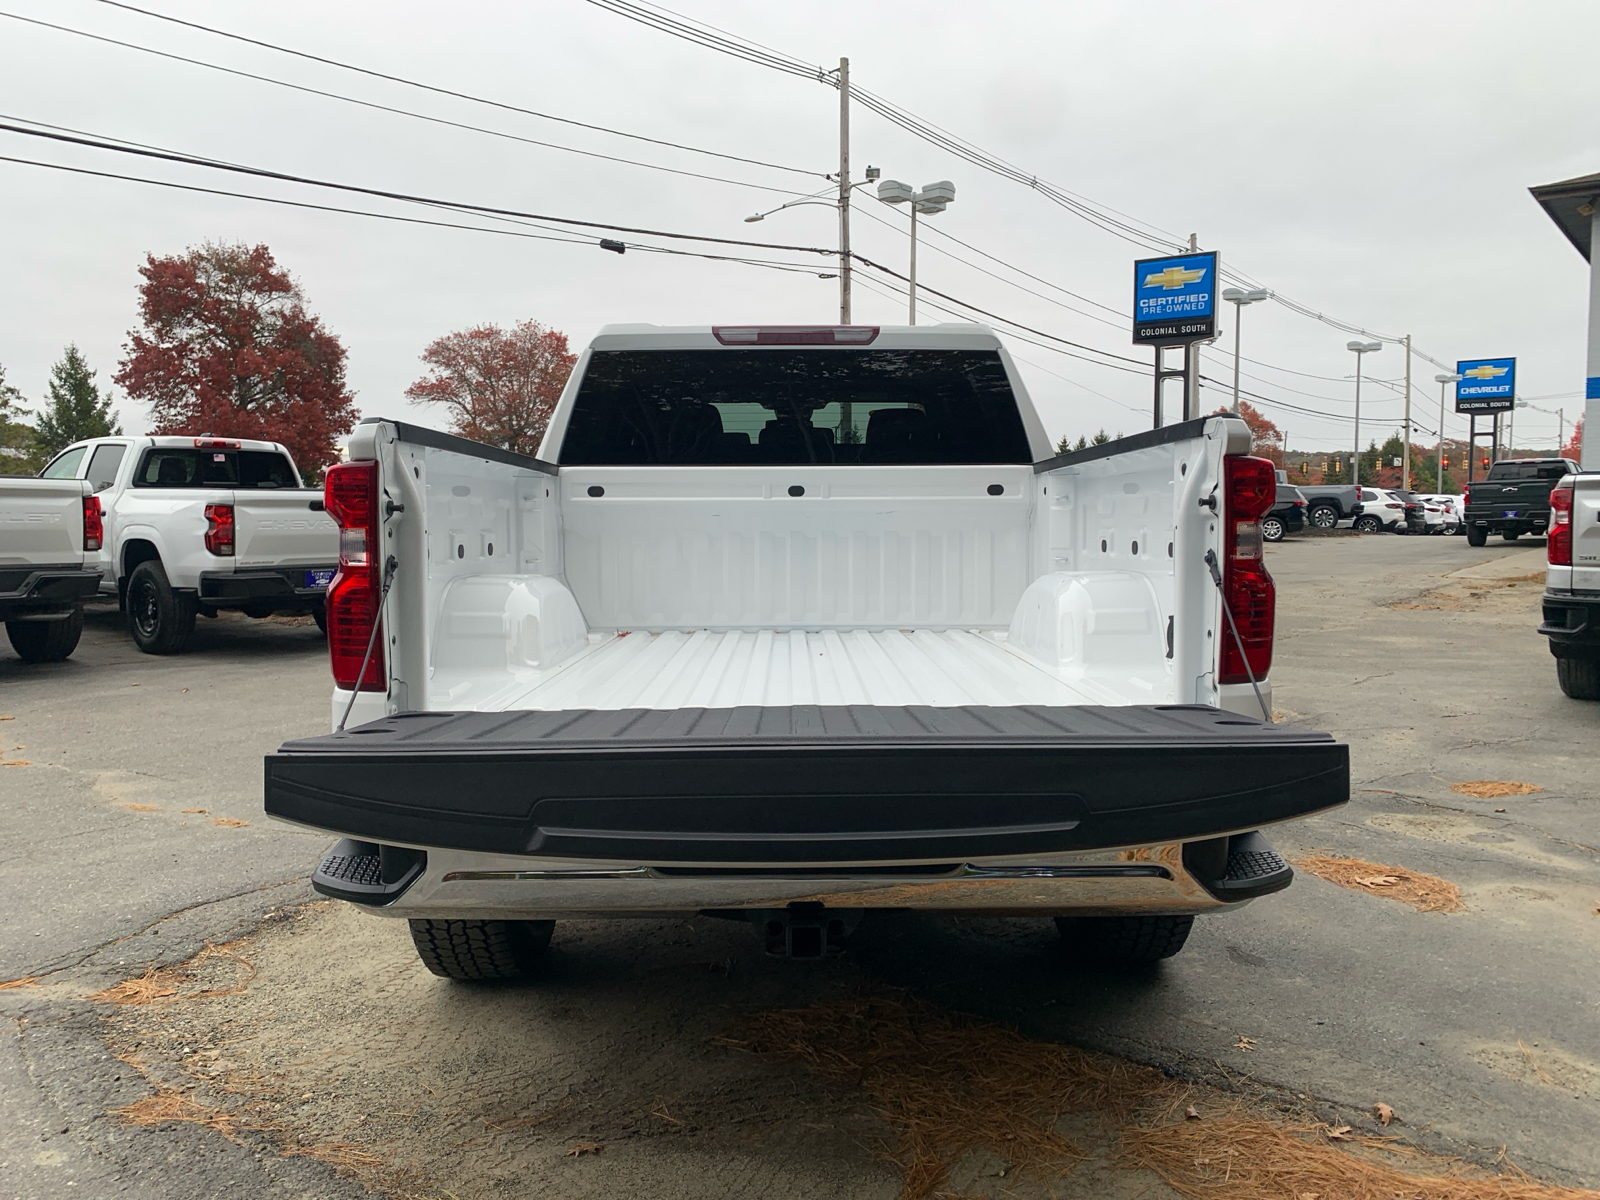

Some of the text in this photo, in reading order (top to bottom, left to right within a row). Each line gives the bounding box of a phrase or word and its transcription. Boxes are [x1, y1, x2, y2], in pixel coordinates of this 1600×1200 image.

[1140, 293, 1208, 307] CERTIFIED
[1143, 302, 1205, 314] PRE-OWNED
[1141, 324, 1206, 336] COLONIAL SOUTH
[1460, 385, 1510, 394] CHEVROLET
[0, 512, 61, 523] LET
[257, 519, 339, 529] CHEVR
